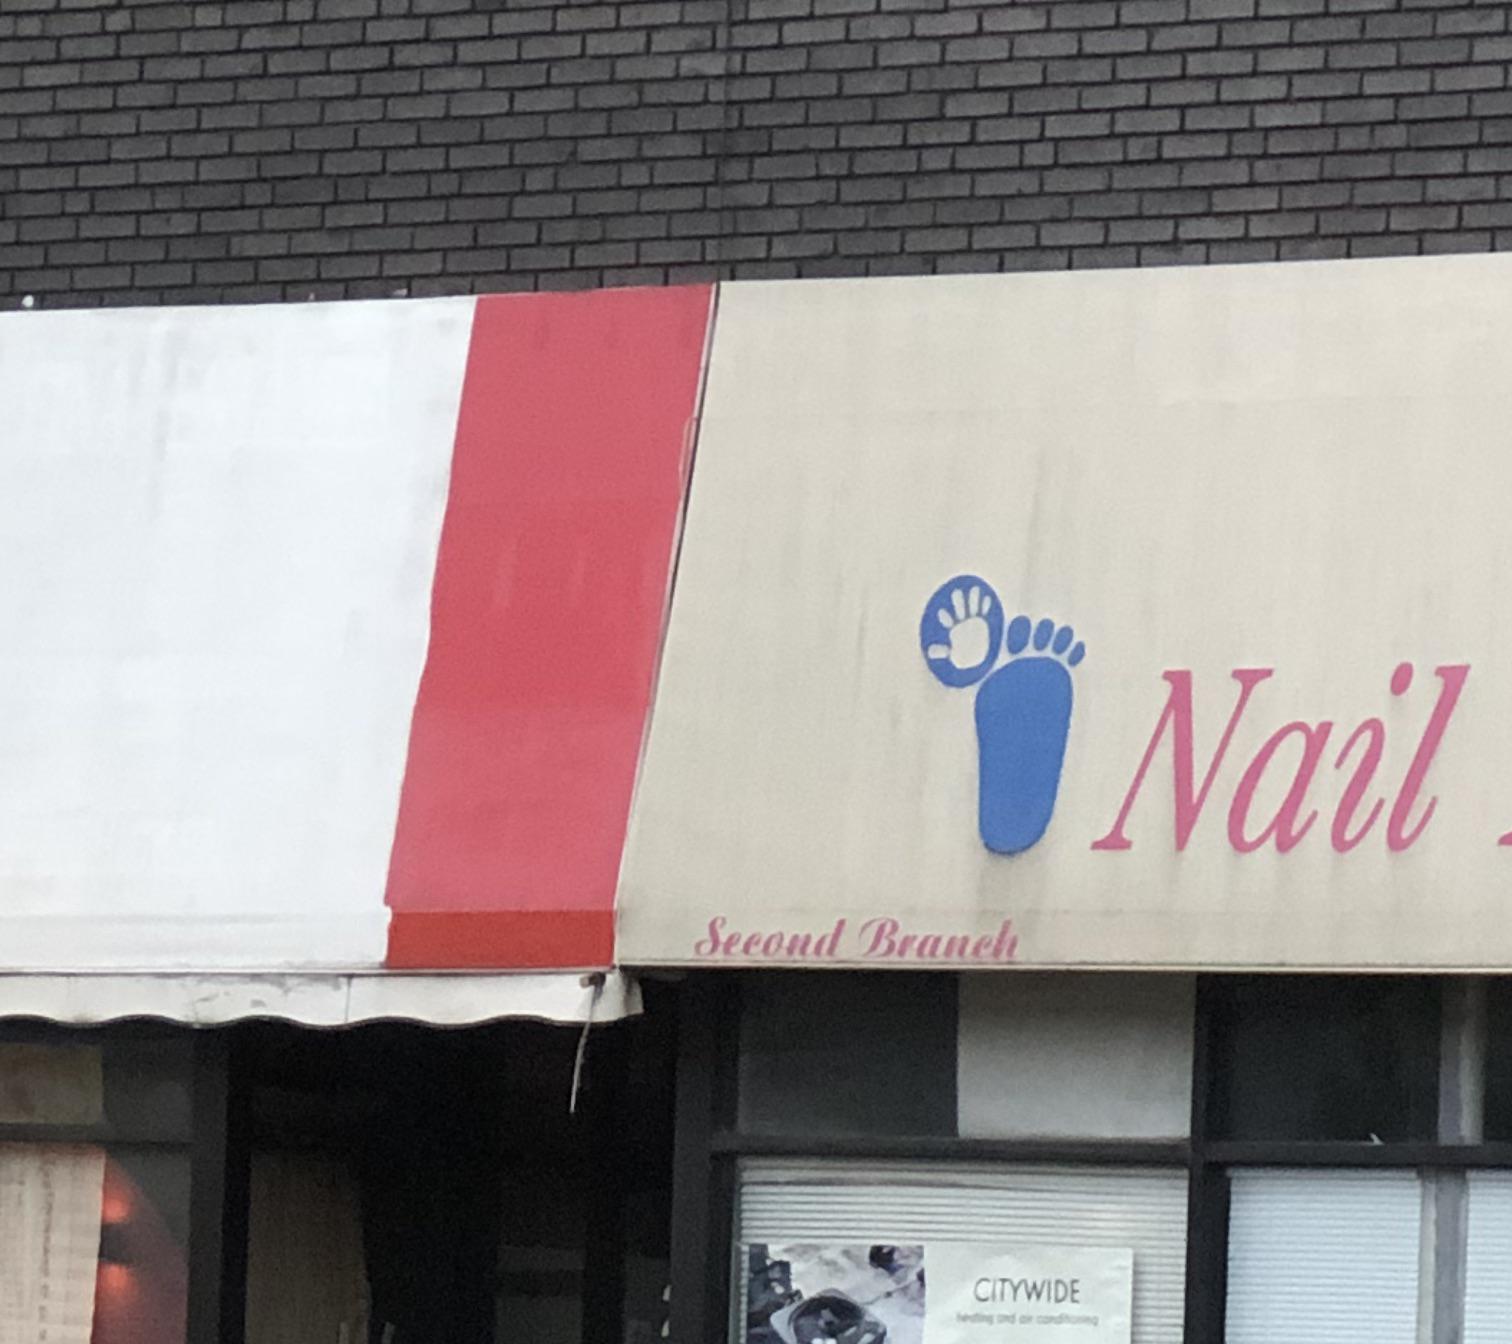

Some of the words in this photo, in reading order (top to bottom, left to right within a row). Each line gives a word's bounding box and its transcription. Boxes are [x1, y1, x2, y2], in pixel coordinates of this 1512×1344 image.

[1090, 662, 1472, 855] Nail
[694, 916, 847, 958] Second
[858, 917, 1020, 961] Branch
[973, 1277, 1081, 1304] CITYWIDE
